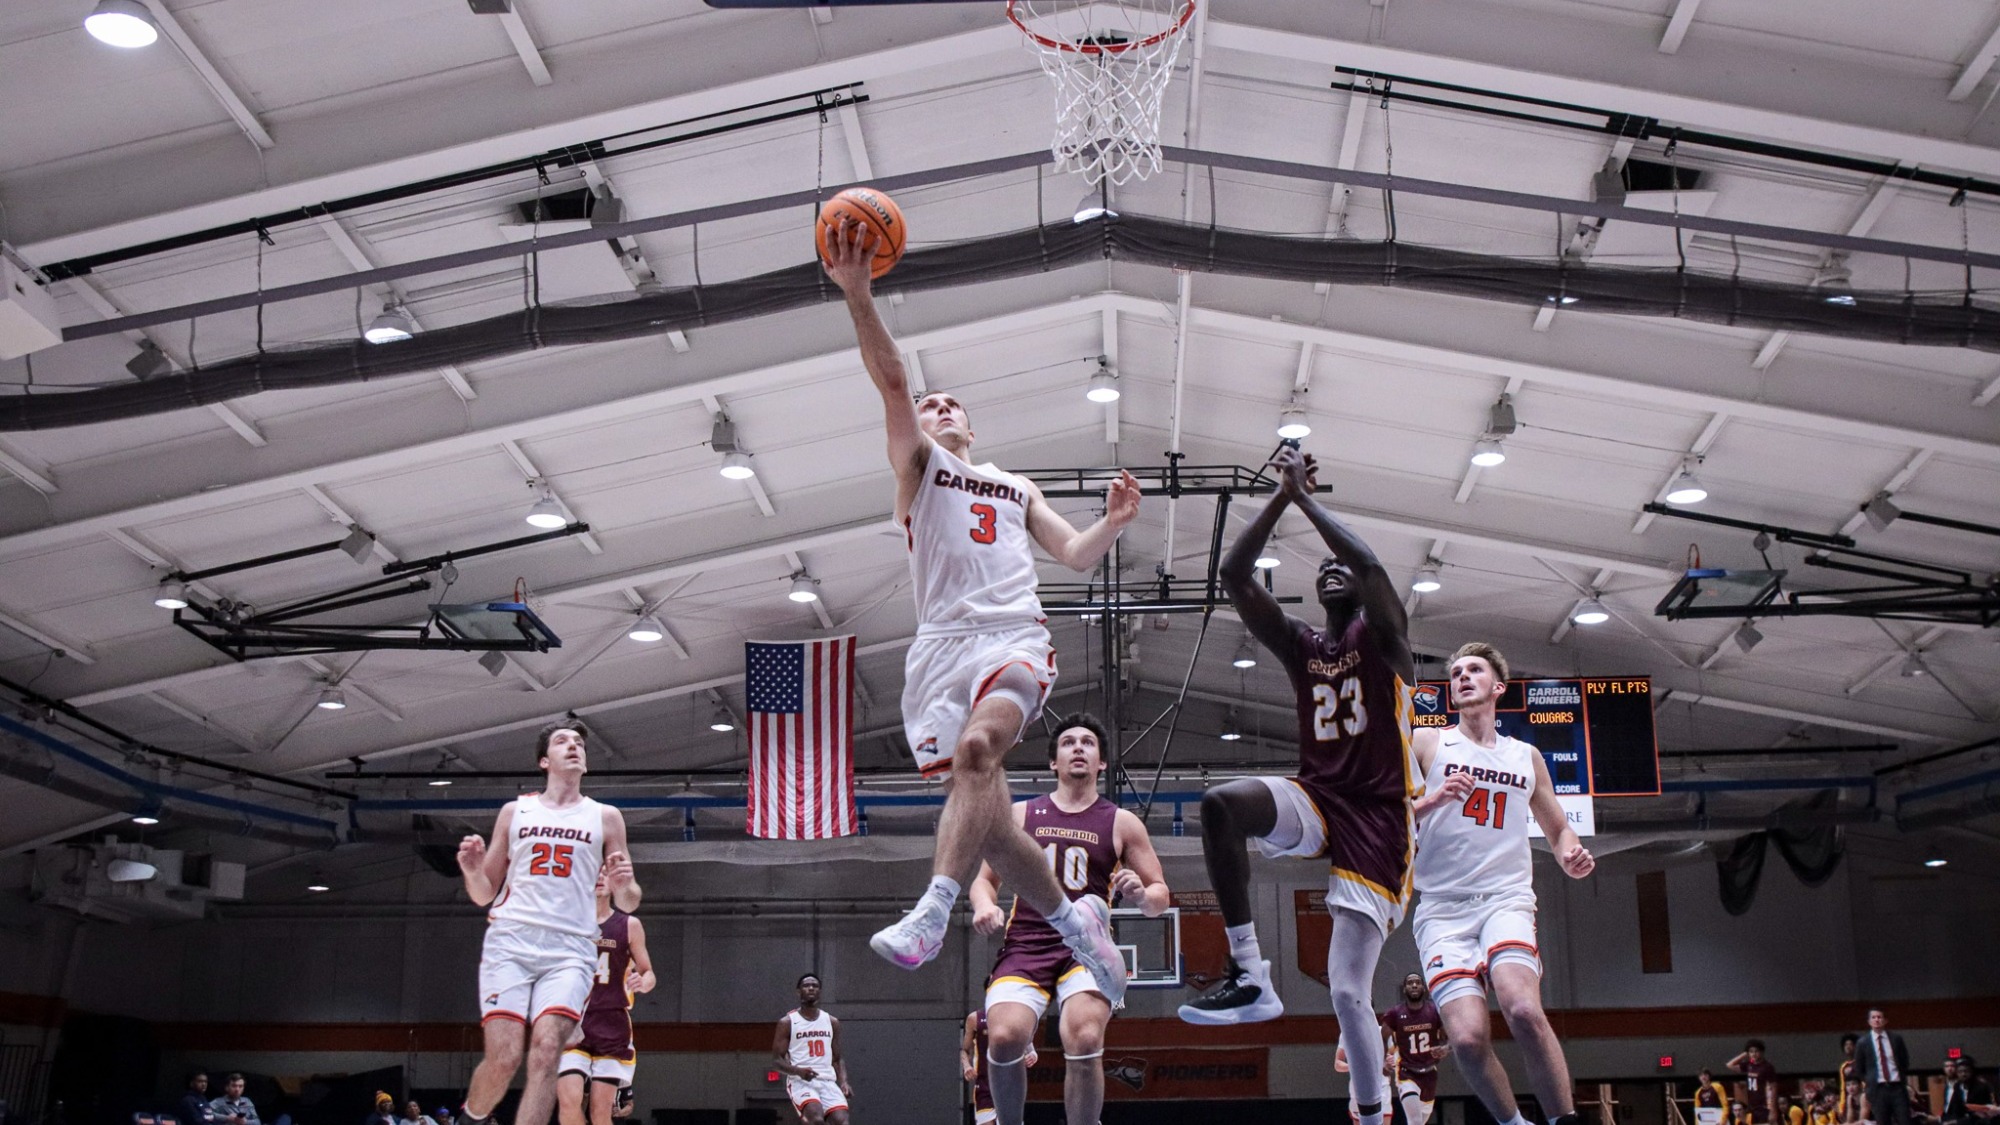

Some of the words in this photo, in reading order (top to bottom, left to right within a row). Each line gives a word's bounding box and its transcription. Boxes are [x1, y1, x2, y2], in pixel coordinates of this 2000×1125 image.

[934, 469, 1024, 508] CARROLL
[970, 502, 997, 545] 3
[1528, 687, 1579, 696] CARROLL
[1587, 683, 1606, 694] PLY
[1612, 682, 1625, 693] FL
[1628, 682, 1648, 693] PTS
[1312, 677, 1368, 741] 23
[1527, 695, 1581, 705] PIONEERS
[1530, 712, 1574, 724] COUGARS
[1553, 753, 1578, 761] FOULS
[1444, 763, 1528, 790] CARROLL
[1555, 785, 1581, 793] SCORE
[1462, 787, 1508, 830] 41
[518, 826, 592, 845] CARROLL
[1035, 826, 1099, 845] CONCORDIA
[530, 843, 574, 878] 25
[1043, 843, 1089, 891] 10
[796, 1030, 831, 1039] CARROLL
[1408, 1032, 1431, 1055] 12
[807, 1040, 825, 1057] 10
[1152, 1064, 1259, 1082] PIONEERS
